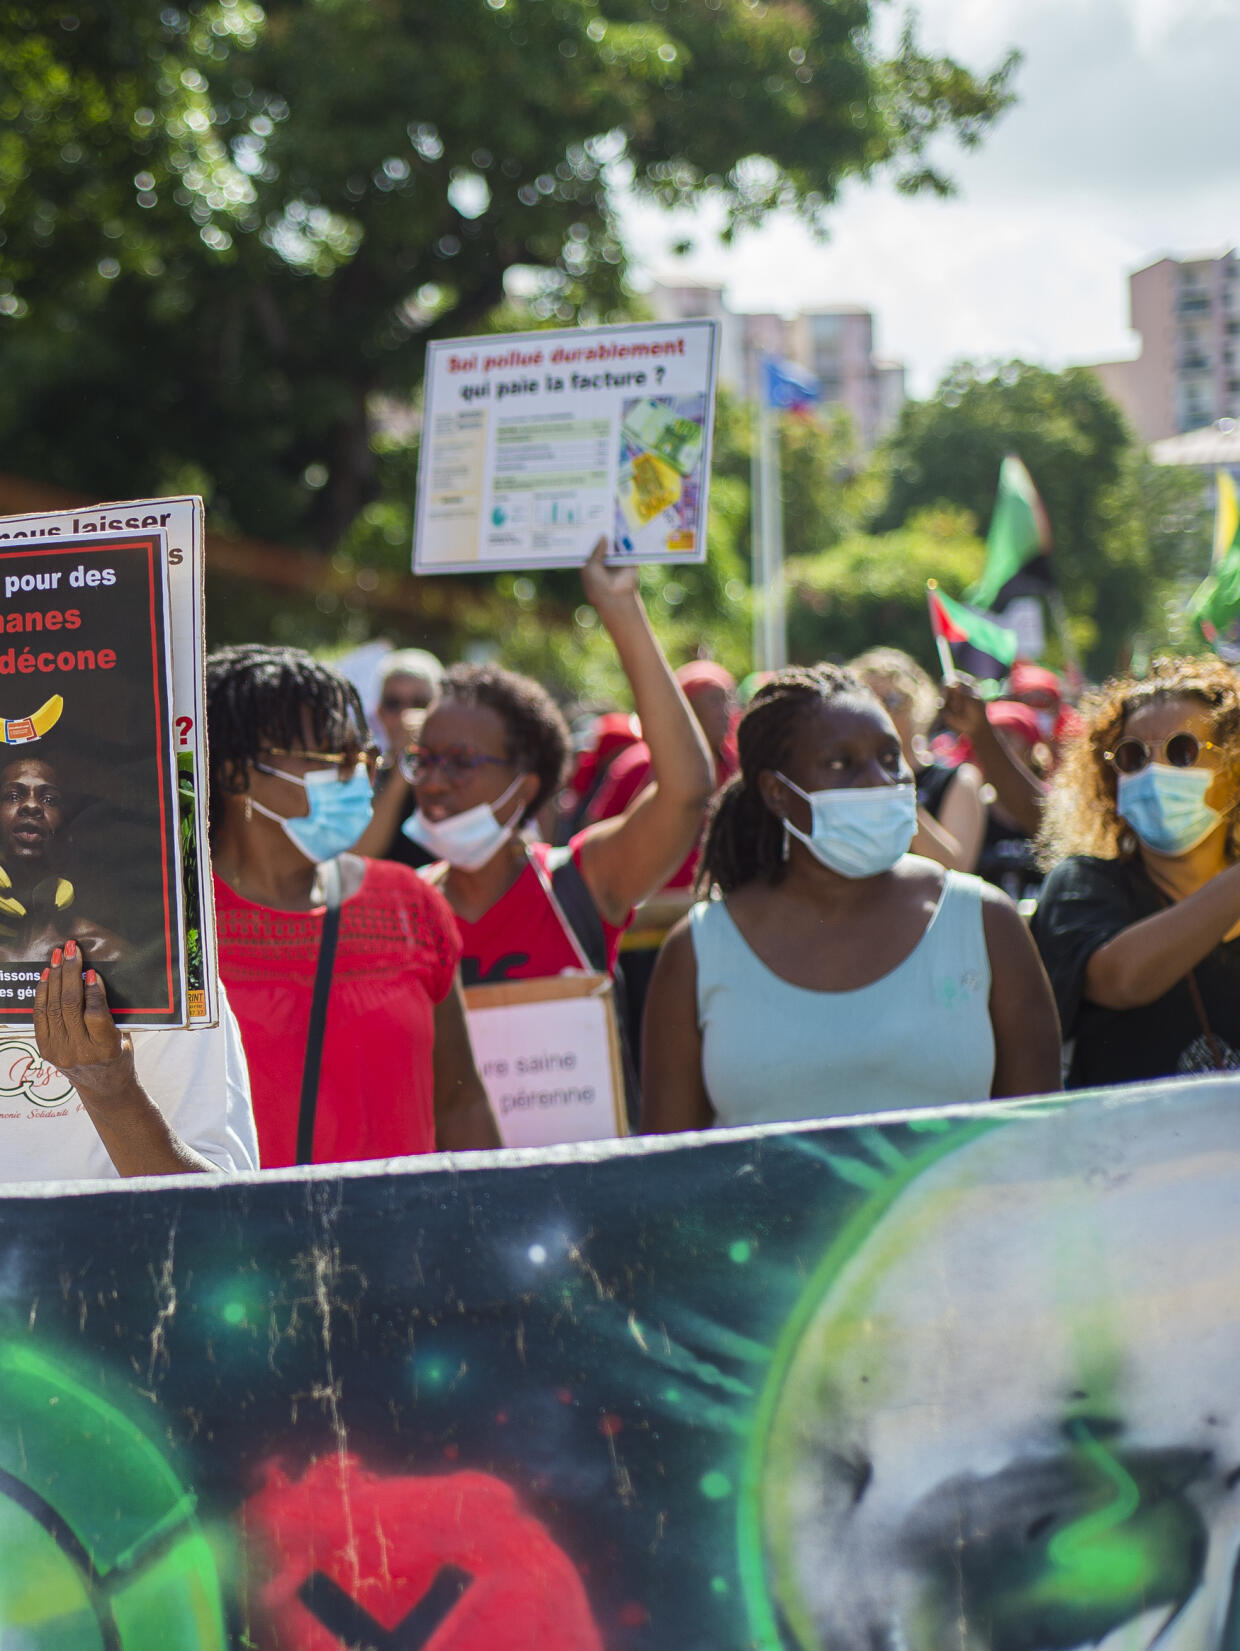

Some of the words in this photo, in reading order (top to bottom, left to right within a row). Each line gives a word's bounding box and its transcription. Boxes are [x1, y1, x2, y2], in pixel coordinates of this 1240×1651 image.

[447, 354, 477, 374] Sol
[484, 351, 543, 374] pollué
[550, 338, 686, 366] durablement
[461, 382, 490, 402] qui
[497, 376, 538, 401] paie
[545, 372, 564, 392] la
[571, 367, 647, 391] facture
[73, 513, 171, 534] laisser
[5, 571, 62, 598] pour
[69, 565, 117, 587] des
[515, 1052, 576, 1076] saine
[500, 1086, 595, 1115] pérenne
